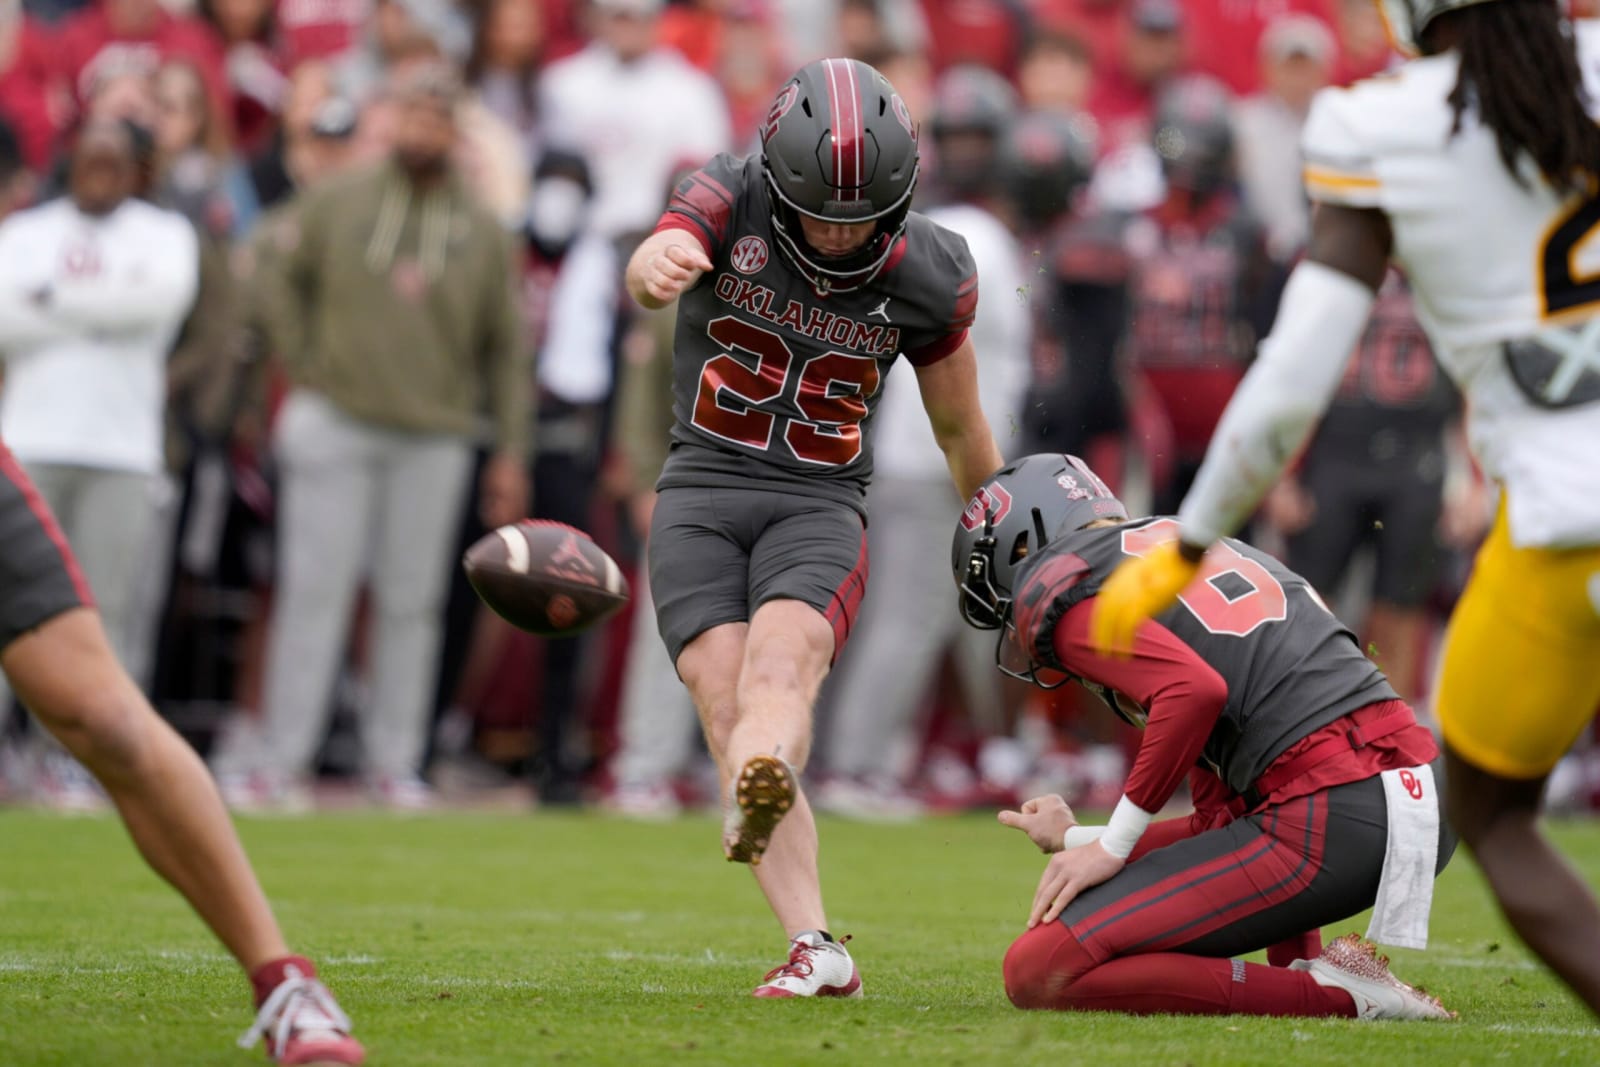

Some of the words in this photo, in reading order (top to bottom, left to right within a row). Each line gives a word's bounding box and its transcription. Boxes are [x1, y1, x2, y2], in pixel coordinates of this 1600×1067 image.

[732, 239, 767, 271] SEC
[713, 273, 902, 355] OKLAHOMA
[691, 315, 880, 466] 29
[1399, 769, 1423, 800] OU
